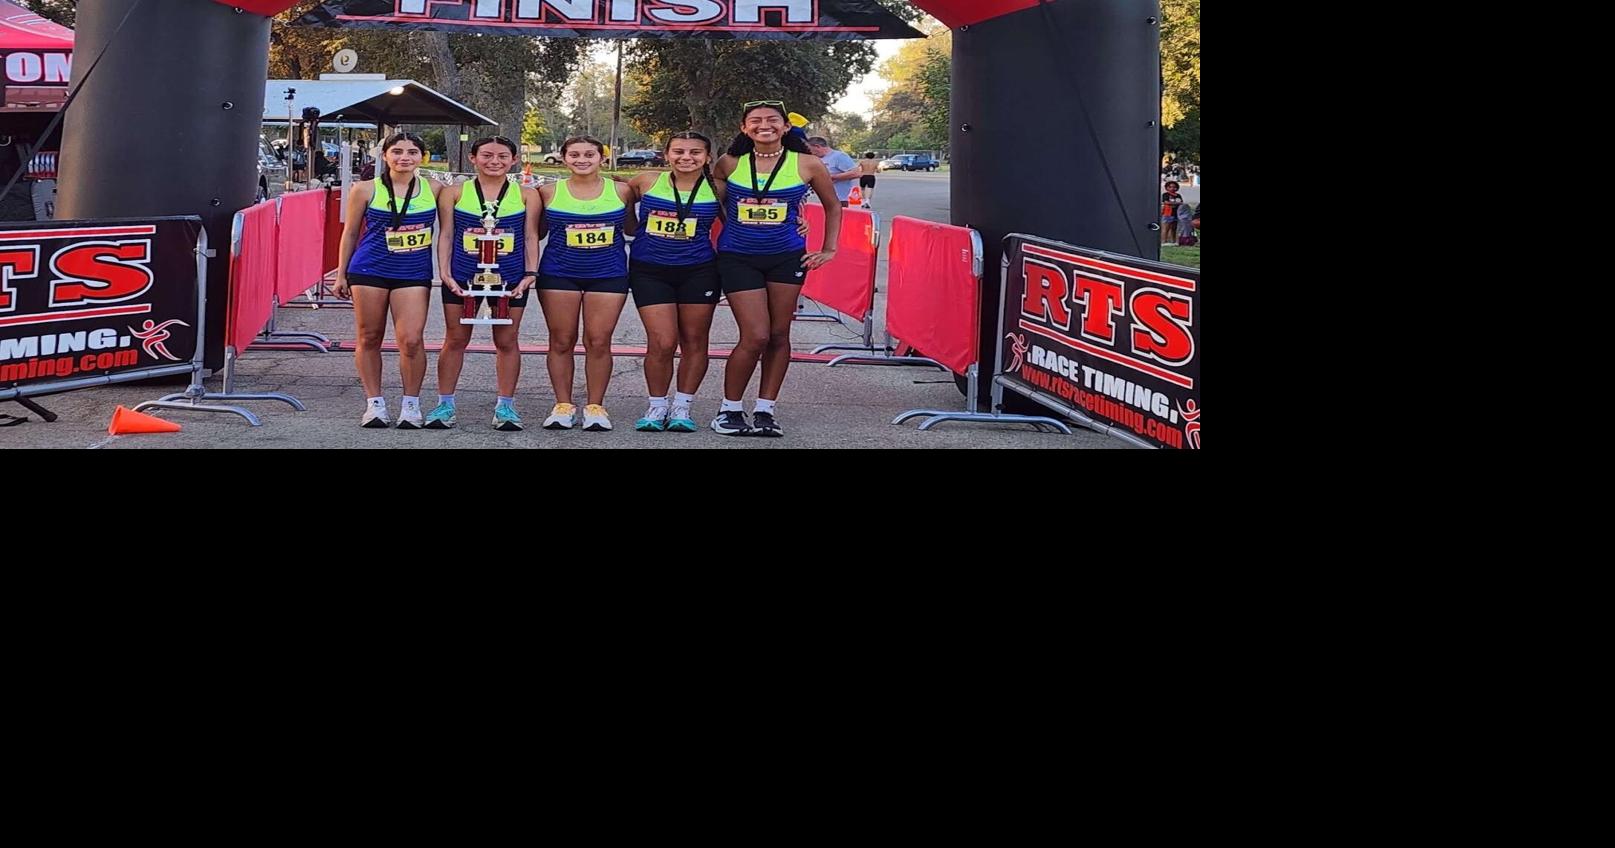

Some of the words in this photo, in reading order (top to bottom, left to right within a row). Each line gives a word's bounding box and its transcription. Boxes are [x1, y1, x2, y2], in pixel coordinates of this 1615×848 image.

[399, 233, 426, 247] 187
[472, 238, 505, 250] 16
[575, 232, 607, 245] 184
[1020, 257, 1195, 367] RTS
[0, 349, 138, 381] ming.com
